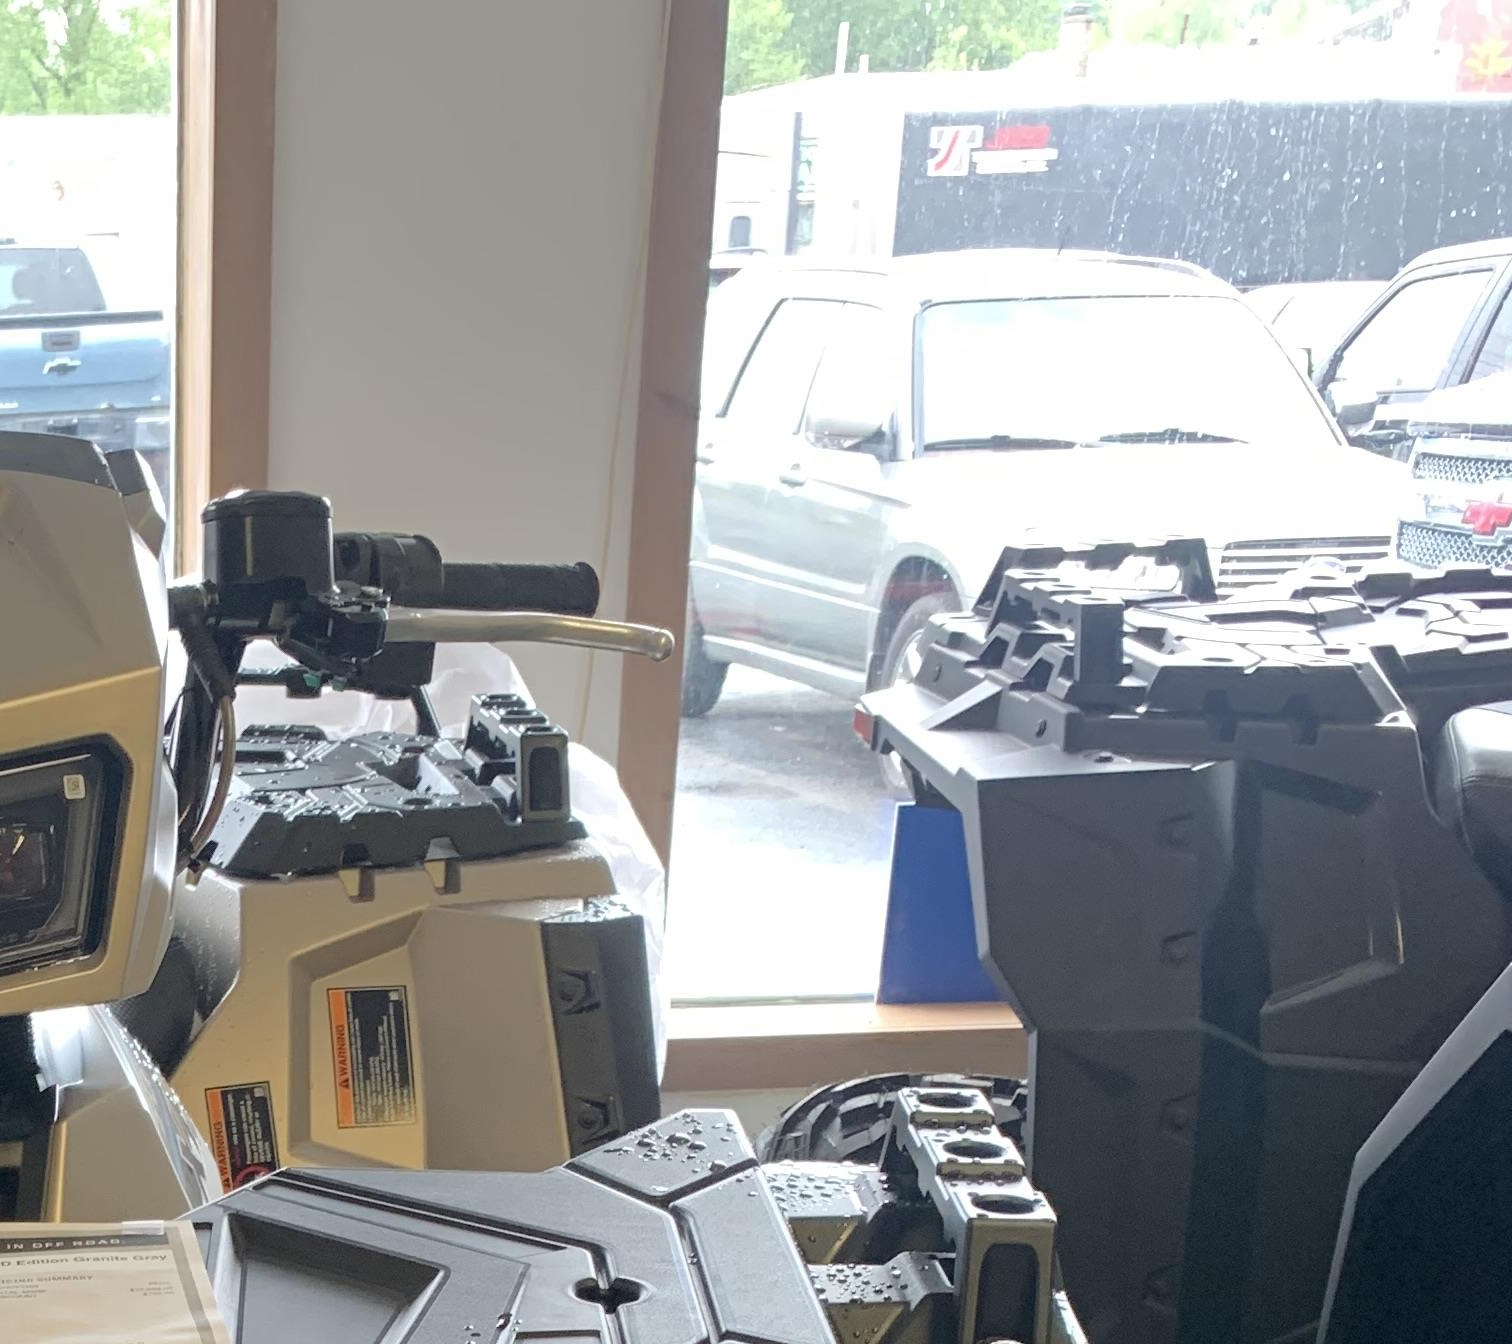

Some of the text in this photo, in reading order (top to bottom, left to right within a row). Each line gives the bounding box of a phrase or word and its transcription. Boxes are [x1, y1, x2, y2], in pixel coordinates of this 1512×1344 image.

[335, 1023, 349, 1076] WARNING
[214, 1121, 228, 1175] WARNING
[6, 1242, 25, 1250] IN
[32, 1241, 66, 1250] OFF
[16, 1256, 70, 1266] Edition
[73, 1254, 129, 1263] Granite
[132, 1253, 168, 1263] Gray
[37, 1274, 94, 1283] SUMMARY
